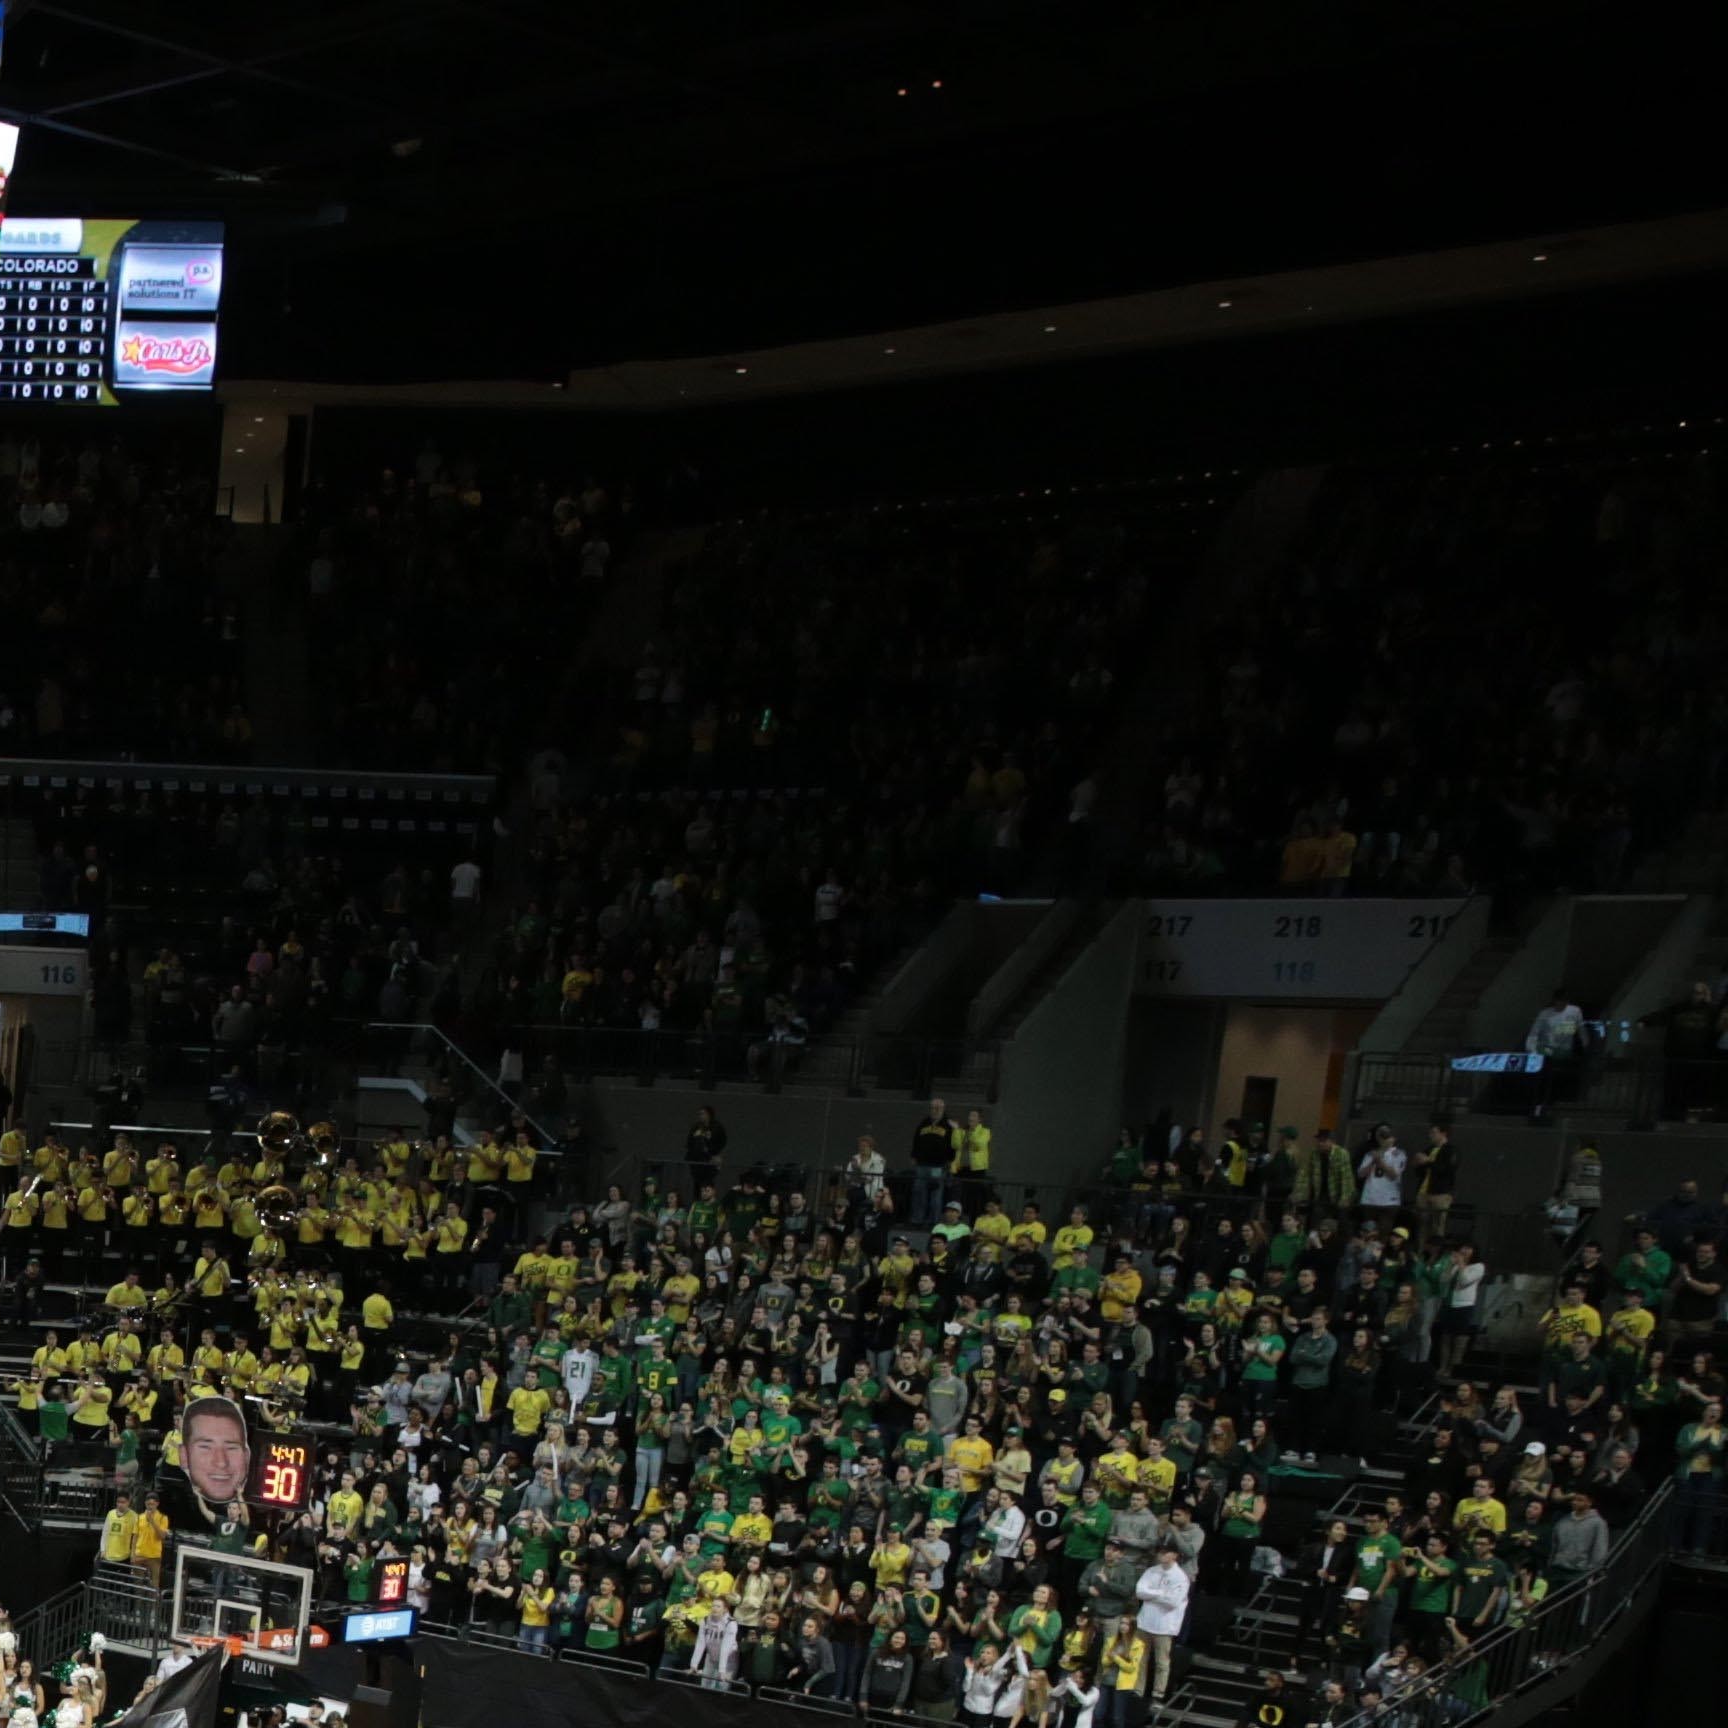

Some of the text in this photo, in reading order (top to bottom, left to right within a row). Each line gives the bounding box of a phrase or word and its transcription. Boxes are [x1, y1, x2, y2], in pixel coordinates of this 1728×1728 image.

[129, 278, 184, 288] partnered
[128, 288, 197, 299] solutions IT
[29, 297, 38, 310] 0
[60, 297, 68, 310] 0
[86, 298, 94, 311] 0
[27, 318, 36, 331] 0
[59, 318, 68, 331] 0
[85, 319, 94, 332] 0
[26, 339, 34, 352] 0
[57, 339, 66, 352] 0
[84, 340, 92, 353] 0
[24, 361, 32, 375] 0
[55, 361, 64, 375] 0
[82, 362, 90, 376] 0
[23, 383, 32, 397] 0
[54, 383, 62, 397] 0
[80, 384, 88, 398] 0
[1149, 916, 1193, 937] 217
[1274, 916, 1322, 937] 218
[41, 965, 76, 984] 116
[1145, 961, 1317, 983] 117 118
[570, 1362, 585, 1378] 21
[271, 1445, 305, 1466] 4:47
[263, 1465, 298, 1502] 30
[383, 1579, 398, 1598] 30
[242, 1659, 275, 1677] PARTY
